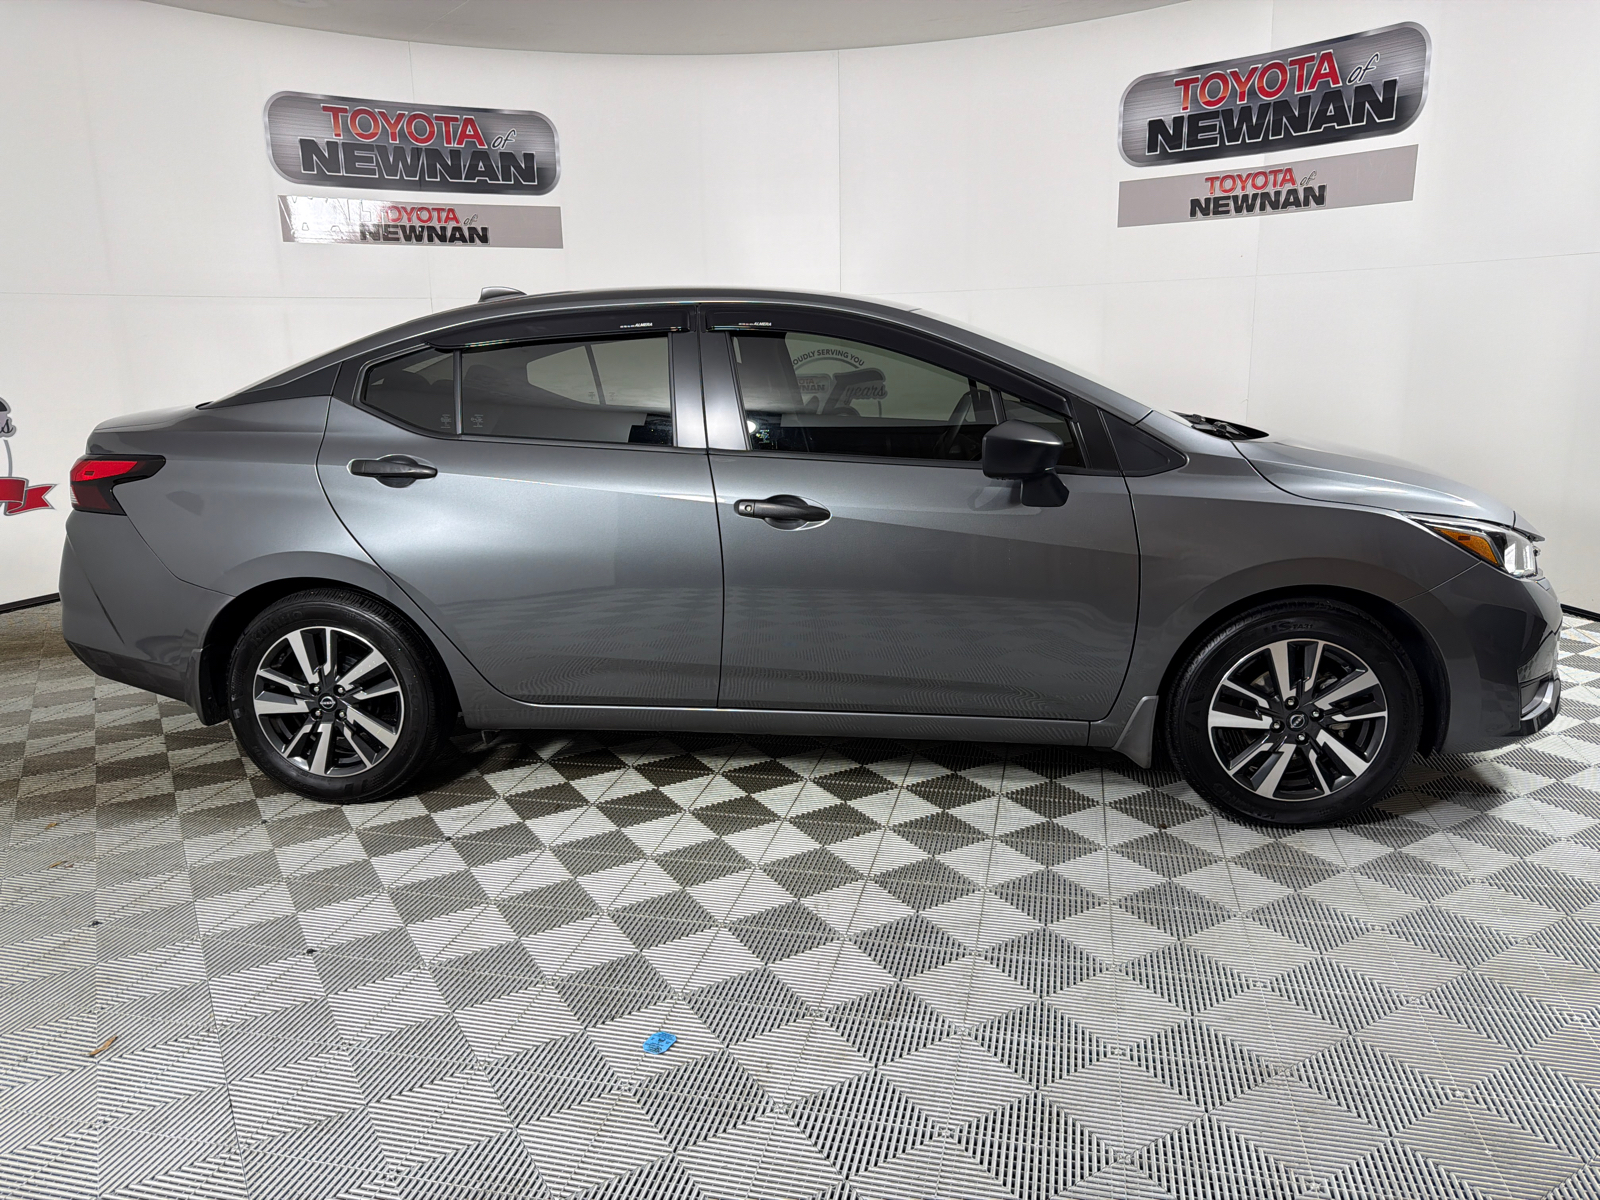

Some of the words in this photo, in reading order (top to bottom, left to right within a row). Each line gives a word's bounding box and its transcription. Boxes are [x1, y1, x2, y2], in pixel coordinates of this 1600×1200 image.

[1174, 49, 1343, 112] TOYOTA
[1346, 52, 1380, 85] of
[322, 104, 487, 149] TOYOTA
[491, 127, 518, 150] of
[1145, 77, 1399, 155] NEWNAN
[298, 137, 538, 187] NEWNAN
[1205, 167, 1297, 195] TOYOTA
[1299, 171, 1317, 187] of
[377, 205, 460, 225] TOYOTA
[463, 213, 479, 226] of
[1189, 184, 1327, 218] NEWNAN
[359, 222, 490, 245] NEWNAN
[793, 350, 816, 366] OUDLY
[817, 348, 849, 359] SERVING
[850, 353, 865, 366] YOU
[845, 384, 886, 405] years
